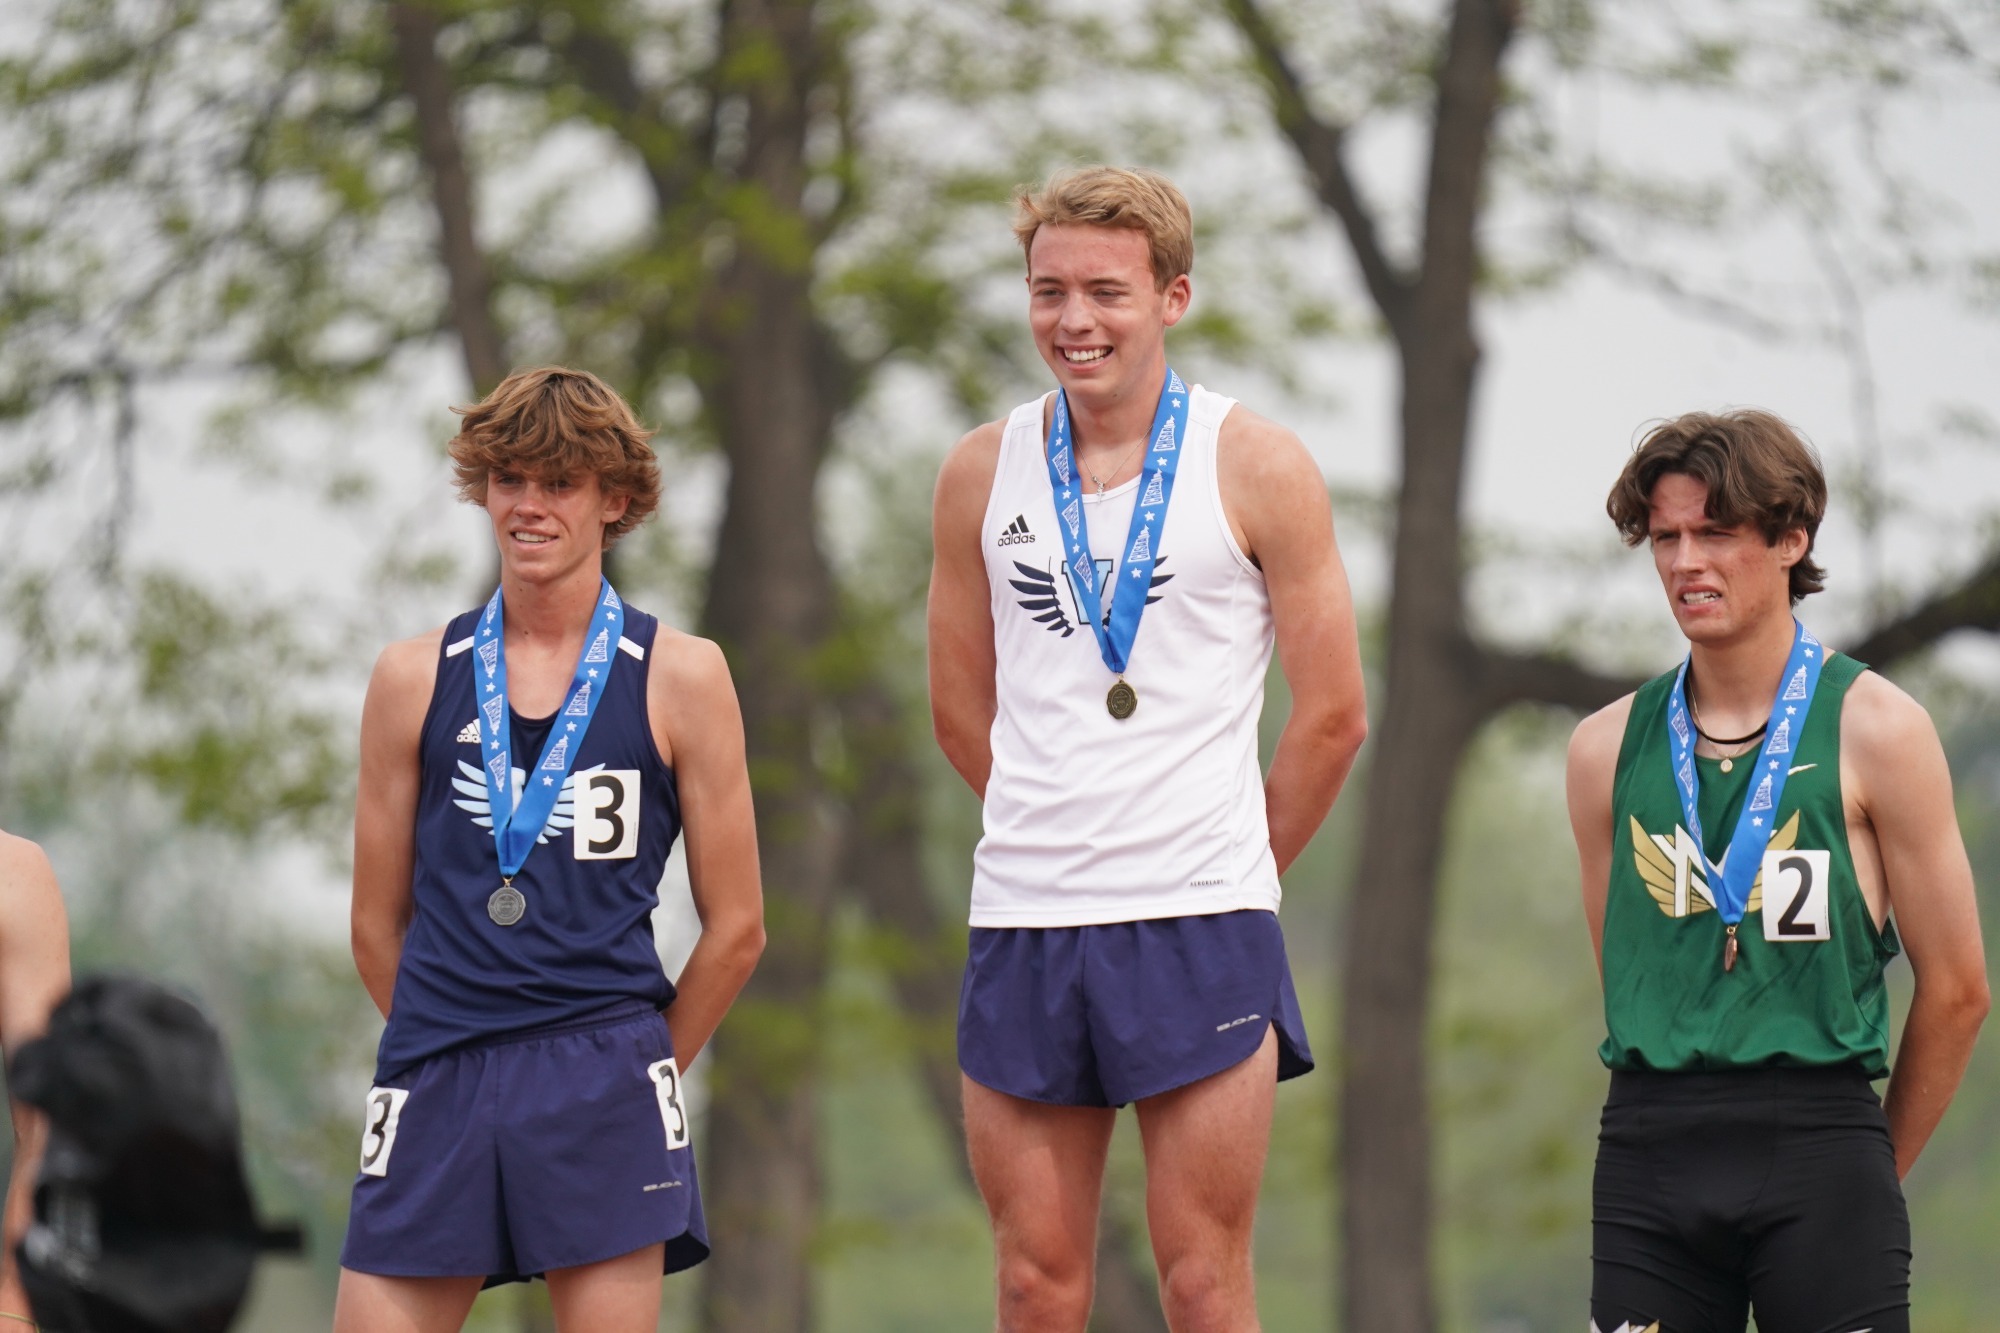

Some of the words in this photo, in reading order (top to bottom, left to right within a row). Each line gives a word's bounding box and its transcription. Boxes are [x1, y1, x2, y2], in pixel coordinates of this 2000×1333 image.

[998, 533, 1036, 547] adidas
[588, 775, 625, 854] 3
[1777, 857, 1816, 935] 2
[363, 1093, 393, 1168] 3
[658, 1065, 684, 1142] 3
